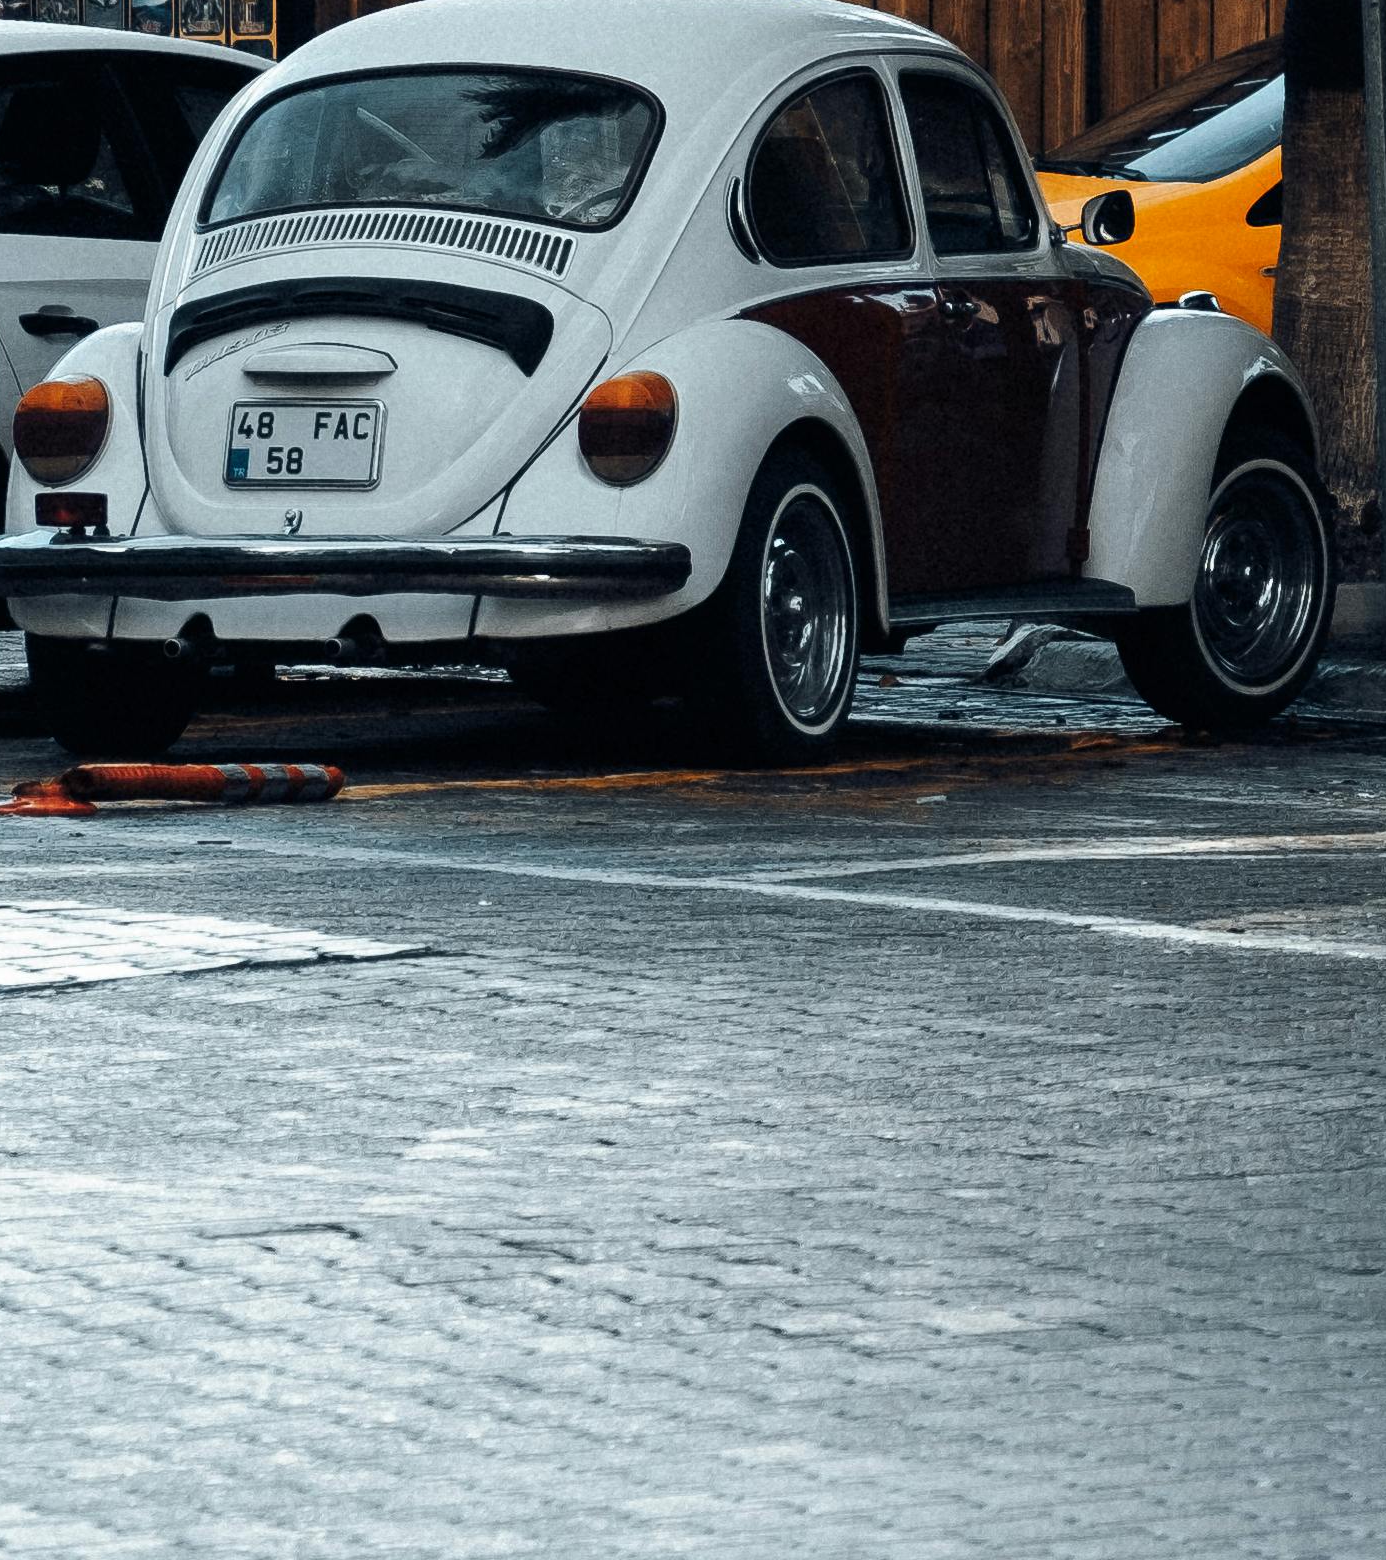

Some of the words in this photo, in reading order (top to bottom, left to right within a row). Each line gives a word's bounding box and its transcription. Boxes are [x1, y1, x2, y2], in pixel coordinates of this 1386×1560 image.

[238, 412, 274, 439] 48
[313, 412, 370, 440] FAC
[233, 467, 245, 476] TR
[266, 446, 303, 475] 58
